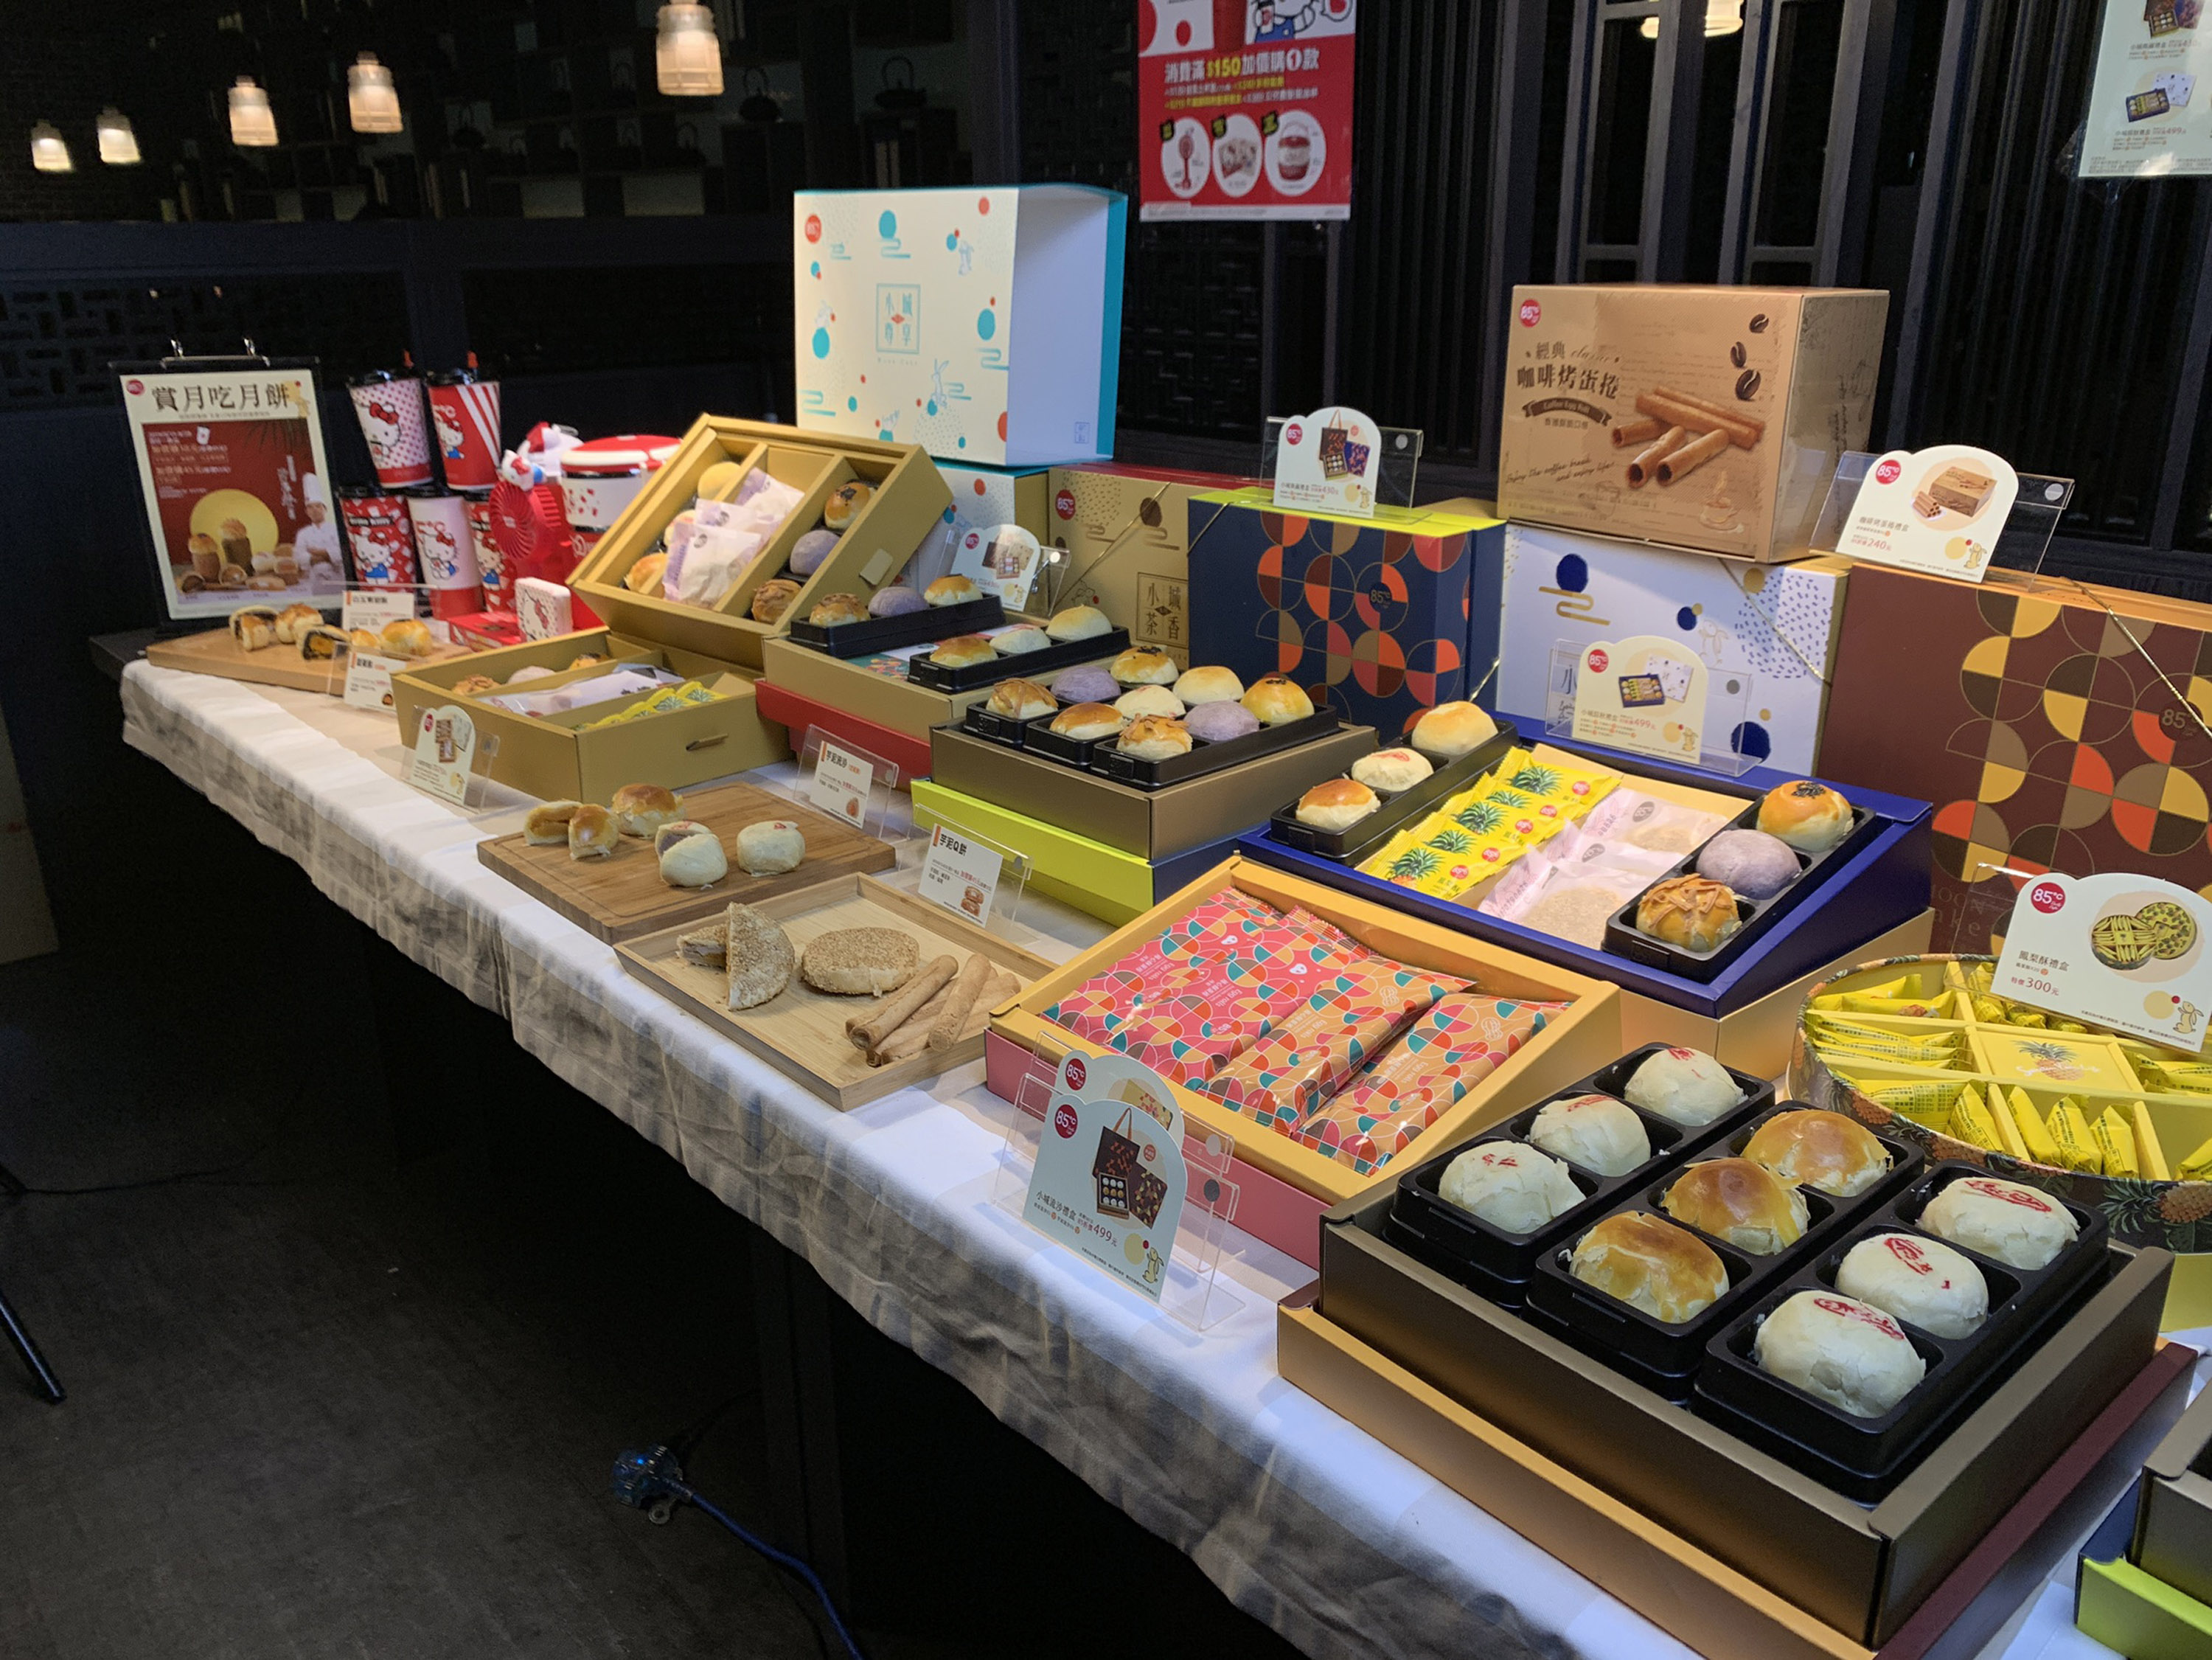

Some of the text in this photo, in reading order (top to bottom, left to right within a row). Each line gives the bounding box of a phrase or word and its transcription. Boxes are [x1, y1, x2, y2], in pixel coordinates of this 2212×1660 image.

[1536, 341, 1565, 360] 經典
[1517, 364, 1619, 400] 咖啡烤蛋捲
[151, 383, 288, 412] 賞月吃月餅
[1877, 465, 1900, 477] 85°C
[2033, 889, 2063, 904] 85°C
[2018, 950, 2070, 972] 鳳梨酥禮盒
[1066, 1064, 1085, 1080] 85°C
[1056, 1110, 1077, 1128] 85°C
[1035, 1190, 1077, 1222] 小城流沙禮盒
